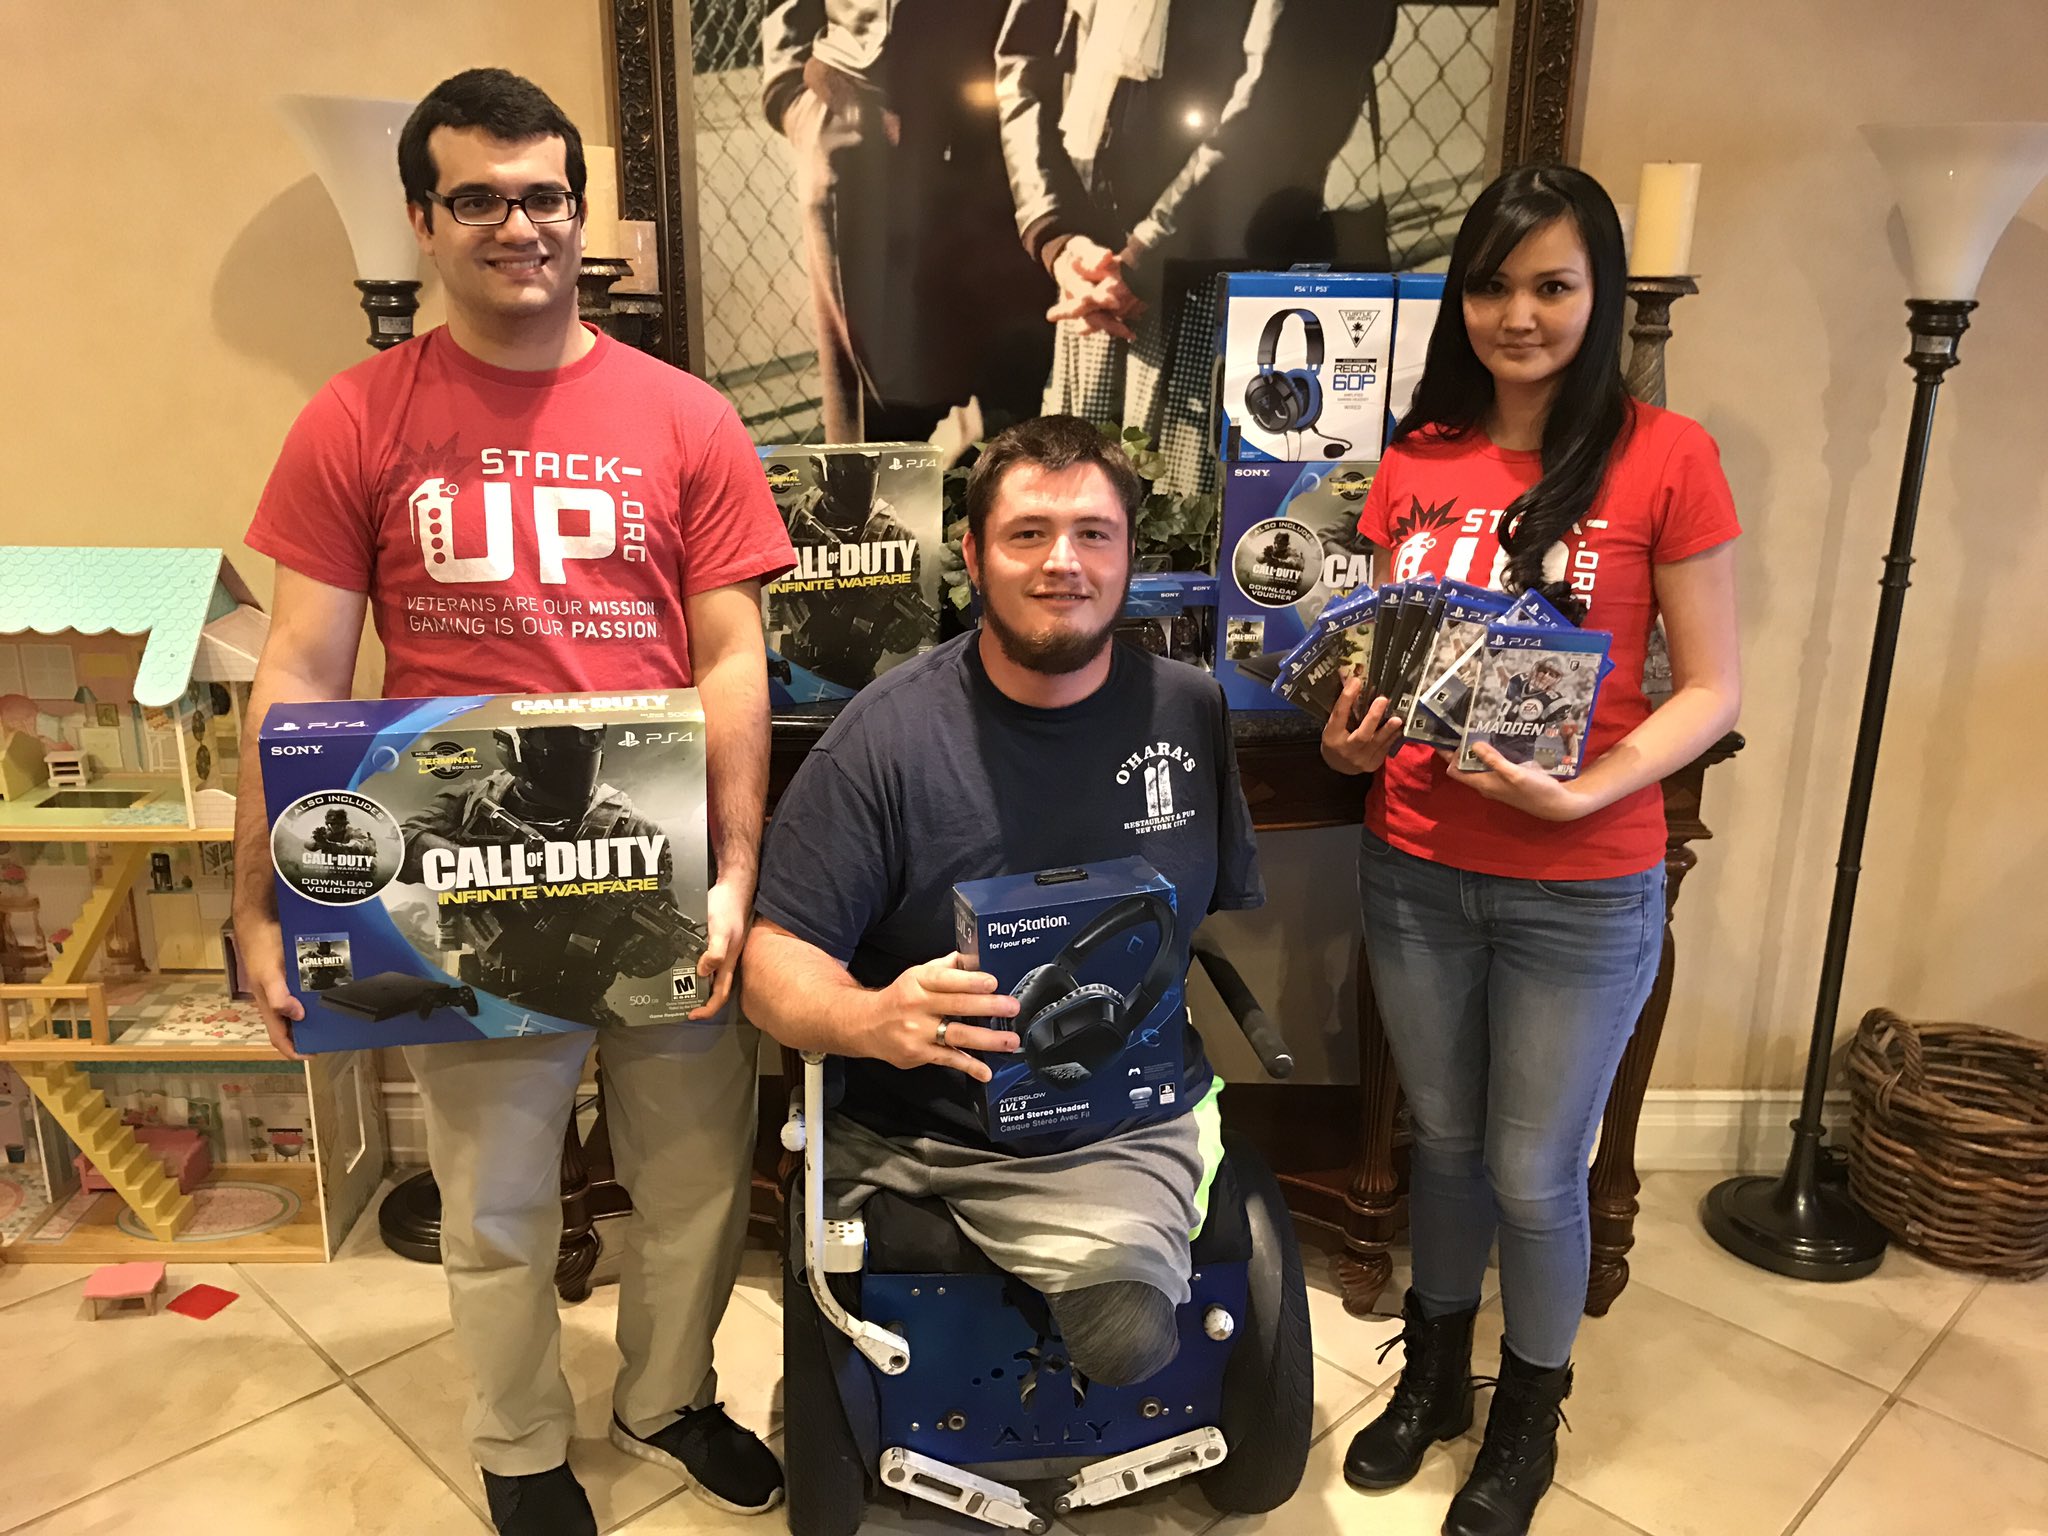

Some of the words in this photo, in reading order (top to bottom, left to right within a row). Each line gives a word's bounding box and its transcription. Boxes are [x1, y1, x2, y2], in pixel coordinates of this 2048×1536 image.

[1334, 364, 1376, 373] RECON
[1333, 374, 1376, 390] 60P
[481, 448, 642, 483] STACK-
[906, 458, 937, 468] PS4
[408, 477, 616, 584] UP
[621, 490, 646, 563] .ORG
[1254, 522, 1276, 536] ALSO
[1279, 522, 1315, 544] INCLUDES
[778, 546, 834, 581] ALL
[828, 551, 840, 565] OF
[840, 540, 917, 578] DUTY
[1252, 564, 1274, 576] CALL
[1276, 568, 1302, 580] DUTY
[1323, 554, 1374, 588] CA
[768, 579, 834, 594] INFINITE
[837, 573, 912, 589] WARFARE
[1248, 584, 1297, 596] DOWNLOAD
[1252, 590, 1292, 601] VOUCHER
[406, 596, 496, 612] VETERANS
[502, 596, 540, 612] ARE
[543, 599, 582, 614] OUR
[589, 600, 659, 616] MISSION.
[1342, 608, 1373, 626] PS4
[410, 615, 486, 634] GAMING
[495, 617, 514, 635] IS
[522, 616, 564, 637] OUR
[572, 621, 660, 638] PASSION.
[1508, 637, 1542, 646] PS4
[1308, 656, 1336, 686] MIN
[512, 698, 580, 712] CALL
[590, 695, 669, 708] DUTY
[308, 720, 366, 730] PS4
[1475, 720, 1544, 736] MADDEN
[646, 732, 694, 744] PS4
[271, 745, 323, 756] SONY
[416, 756, 478, 766] TERMINAL
[1116, 742, 1196, 785] O'HARA'S
[294, 796, 324, 816] ALSO
[328, 795, 384, 820] INCLUDES
[1124, 814, 1176, 830] RESTAURANT
[1182, 810, 1196, 818] PUB
[1135, 826, 1151, 834] NEW
[1152, 822, 1172, 832] YORK
[1174, 819, 1187, 828] CITY
[302, 852, 334, 866] CALL
[338, 854, 374, 868] DUTY
[422, 843, 534, 890] CALL
[526, 851, 544, 868] OF
[544, 835, 666, 883] DUTY
[302, 878, 373, 888] DOWNLOAD
[307, 886, 366, 894] VOUCHER
[438, 886, 538, 905] INFINITE
[540, 878, 659, 898] WARFARE
[988, 915, 1068, 938] PlayStation
[968, 928, 972, 944] 3
[324, 956, 344, 964] DUTY
[674, 976, 694, 994] M
[630, 994, 650, 1006] 500
[999, 1092, 1046, 1104] AFTERGLOW
[1000, 1102, 1018, 1113] LVL
[1020, 1100, 1026, 1110] 3
[1000, 1114, 1024, 1123] Wired
[1026, 1110, 1054, 1118] Stereo
[1056, 1102, 1090, 1114] Headset
[1000, 1122, 1030, 1132] Casque
[1060, 1113, 1078, 1121] Avec
[992, 1420, 1113, 1448] ALLY
